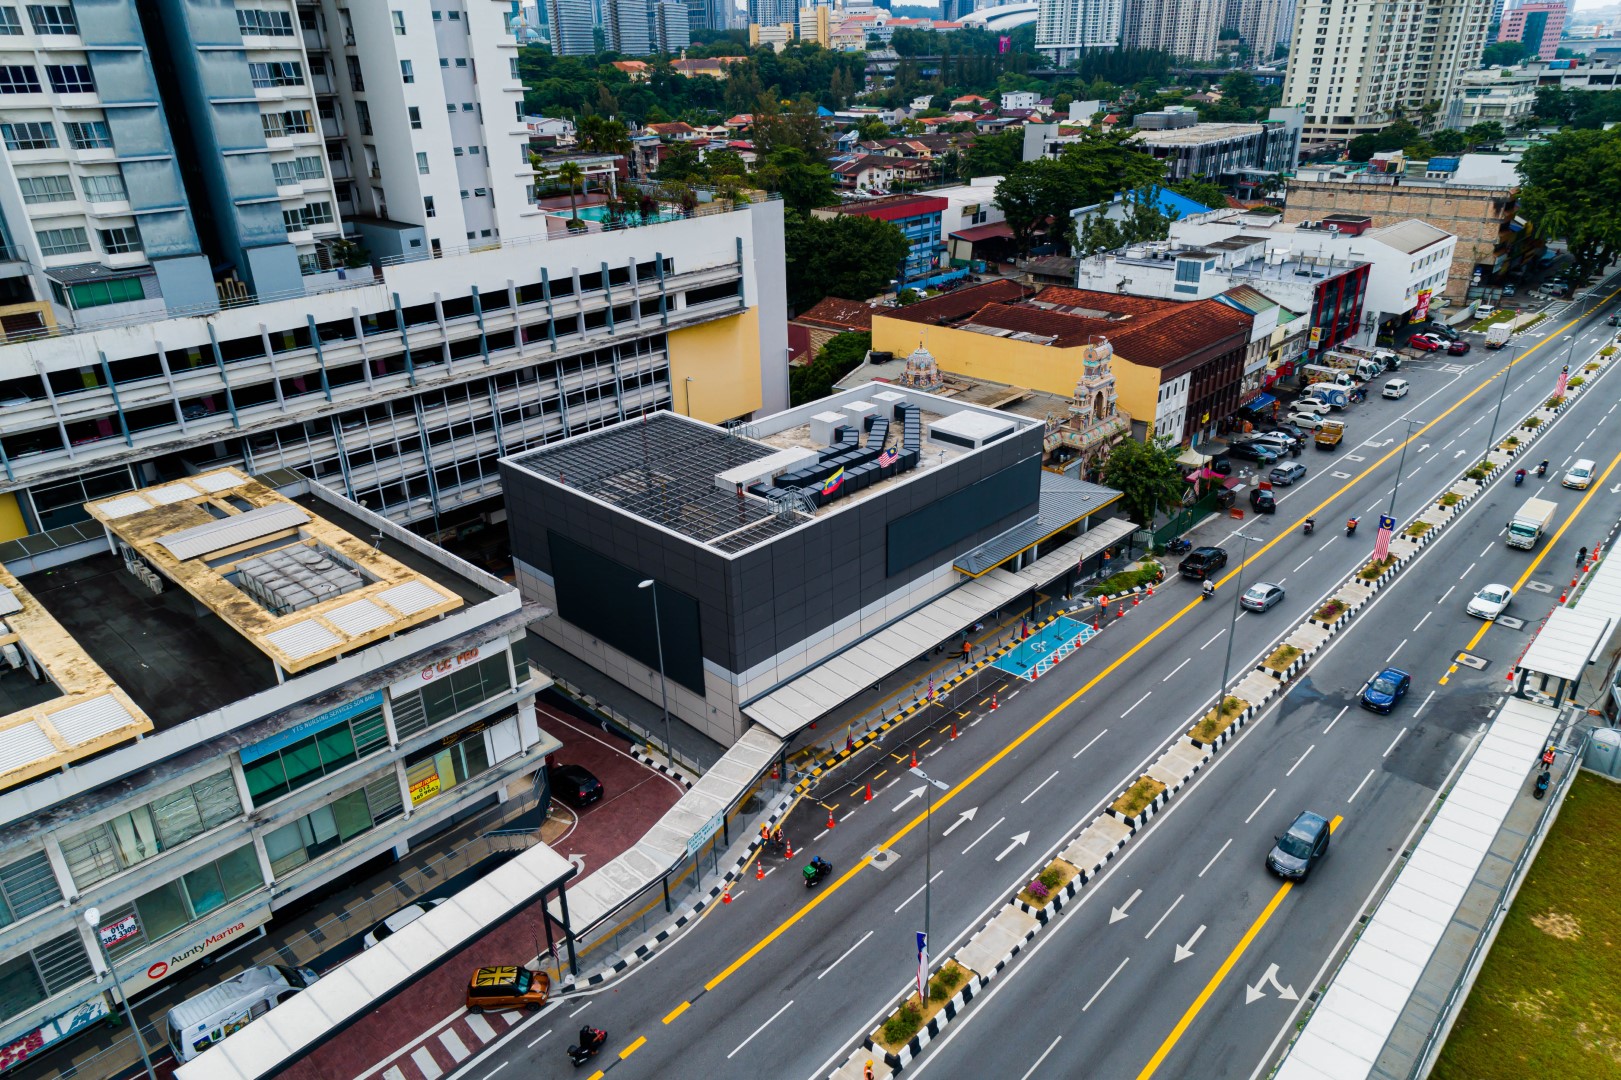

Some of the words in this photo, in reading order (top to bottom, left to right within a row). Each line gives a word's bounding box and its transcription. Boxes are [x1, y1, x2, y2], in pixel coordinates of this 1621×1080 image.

[436, 657, 452, 673] CC
[456, 647, 480, 665] PRO
[304, 714, 329, 729] NURSING
[329, 703, 353, 718] SERVICES
[103, 933, 117, 945] 382
[119, 924, 136, 938] 3309
[110, 923, 125, 934] 019
[170, 921, 245, 966] AuntyMarina
